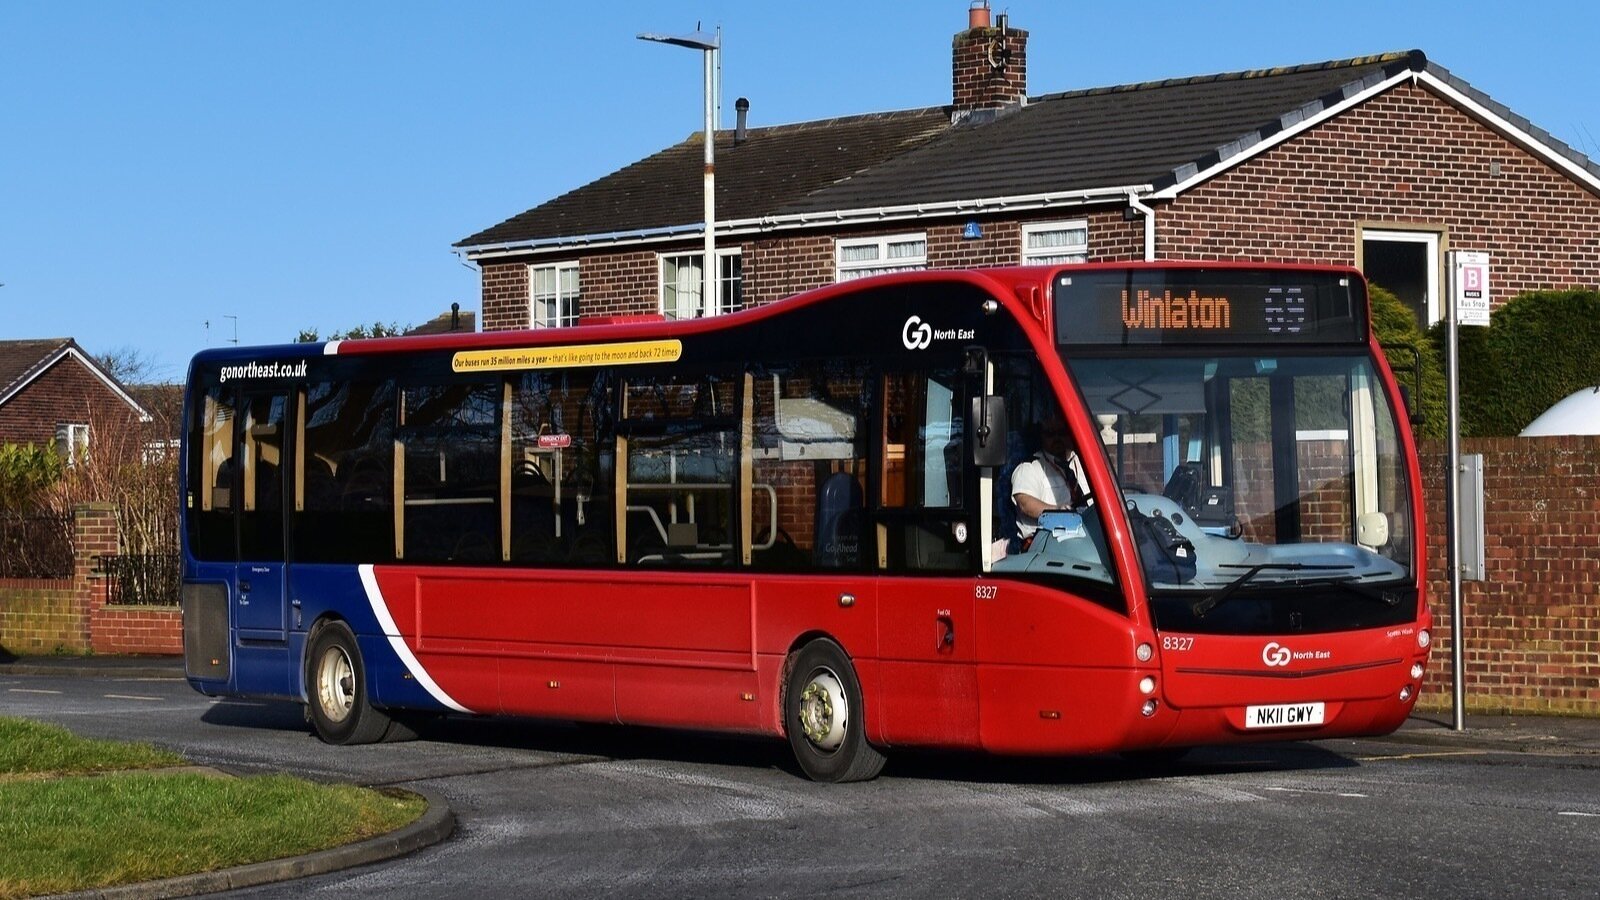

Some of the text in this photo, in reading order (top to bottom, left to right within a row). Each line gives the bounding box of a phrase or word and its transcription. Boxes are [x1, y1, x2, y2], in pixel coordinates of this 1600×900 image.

[1467, 270, 1479, 288] B
[1121, 289, 1231, 329] Winlaton
[1472, 300, 1486, 308] Stop
[933, 329, 957, 340] North
[957, 329, 975, 340] East
[454, 358, 464, 368] Our
[465, 358, 480, 367] buses
[480, 358, 490, 366] run
[490, 356, 498, 366] 35
[498, 356, 516, 365] million
[516, 355, 531, 364] miles
[535, 355, 548, 365] year
[552, 353, 567, 363] that's
[567, 353, 578, 362] like
[578, 353, 594, 363] going
[594, 353, 601, 361] to
[601, 350, 611, 360] the
[611, 351, 627, 359] moon
[627, 348, 639, 359] and
[639, 348, 653, 358] back
[653, 347, 661, 358] 72
[661, 347, 678, 356] times
[219, 359, 308, 383] gonortheast.co.uk
[975, 585, 998, 599] 8327
[1163, 636, 1194, 651] 8327
[1292, 651, 1314, 660] North
[1315, 650, 1331, 659] East
[1287, 705, 1314, 723] GWY
